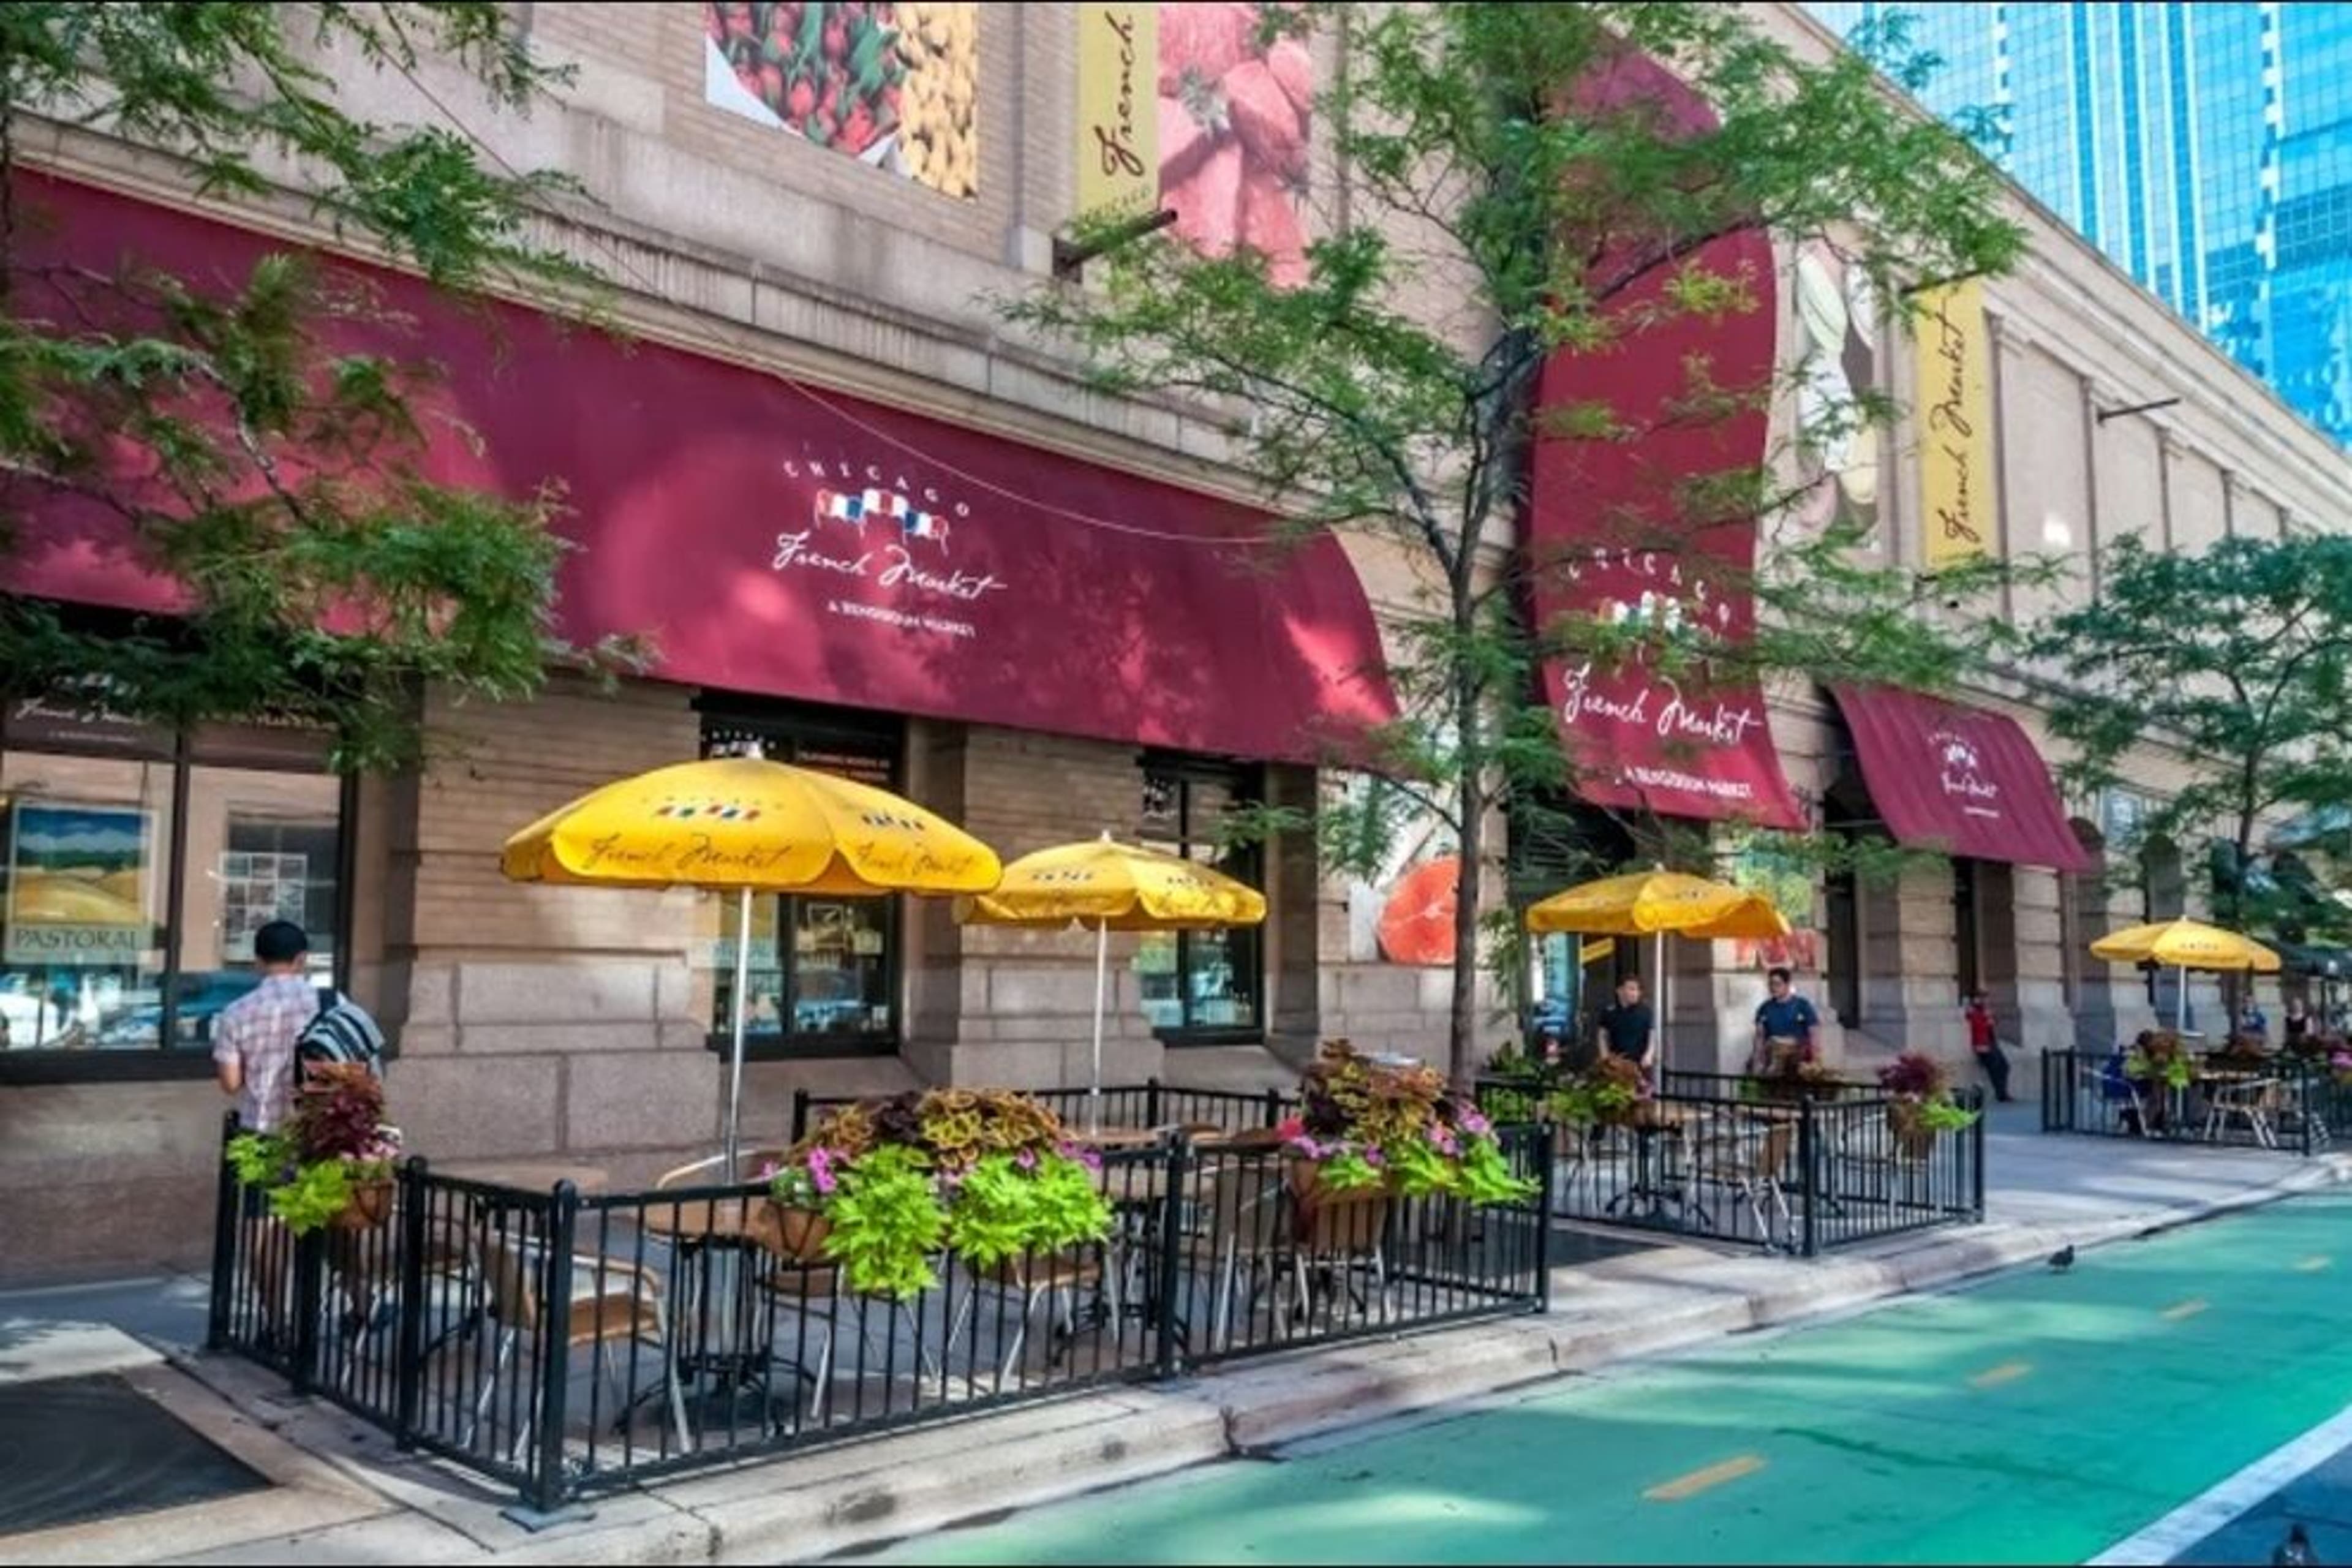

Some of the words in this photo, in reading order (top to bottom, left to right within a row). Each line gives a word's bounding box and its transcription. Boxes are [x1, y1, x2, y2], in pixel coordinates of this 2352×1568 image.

[1094, 10, 1144, 177] French
[1929, 296, 1972, 437] Market
[783, 461, 970, 517] CHICAGO
[1937, 443, 1980, 544] French
[773, 530, 874, 575] French
[878, 543, 1008, 600] Market
[1564, 662, 1649, 723] French
[1657, 674, 1764, 742] Market
